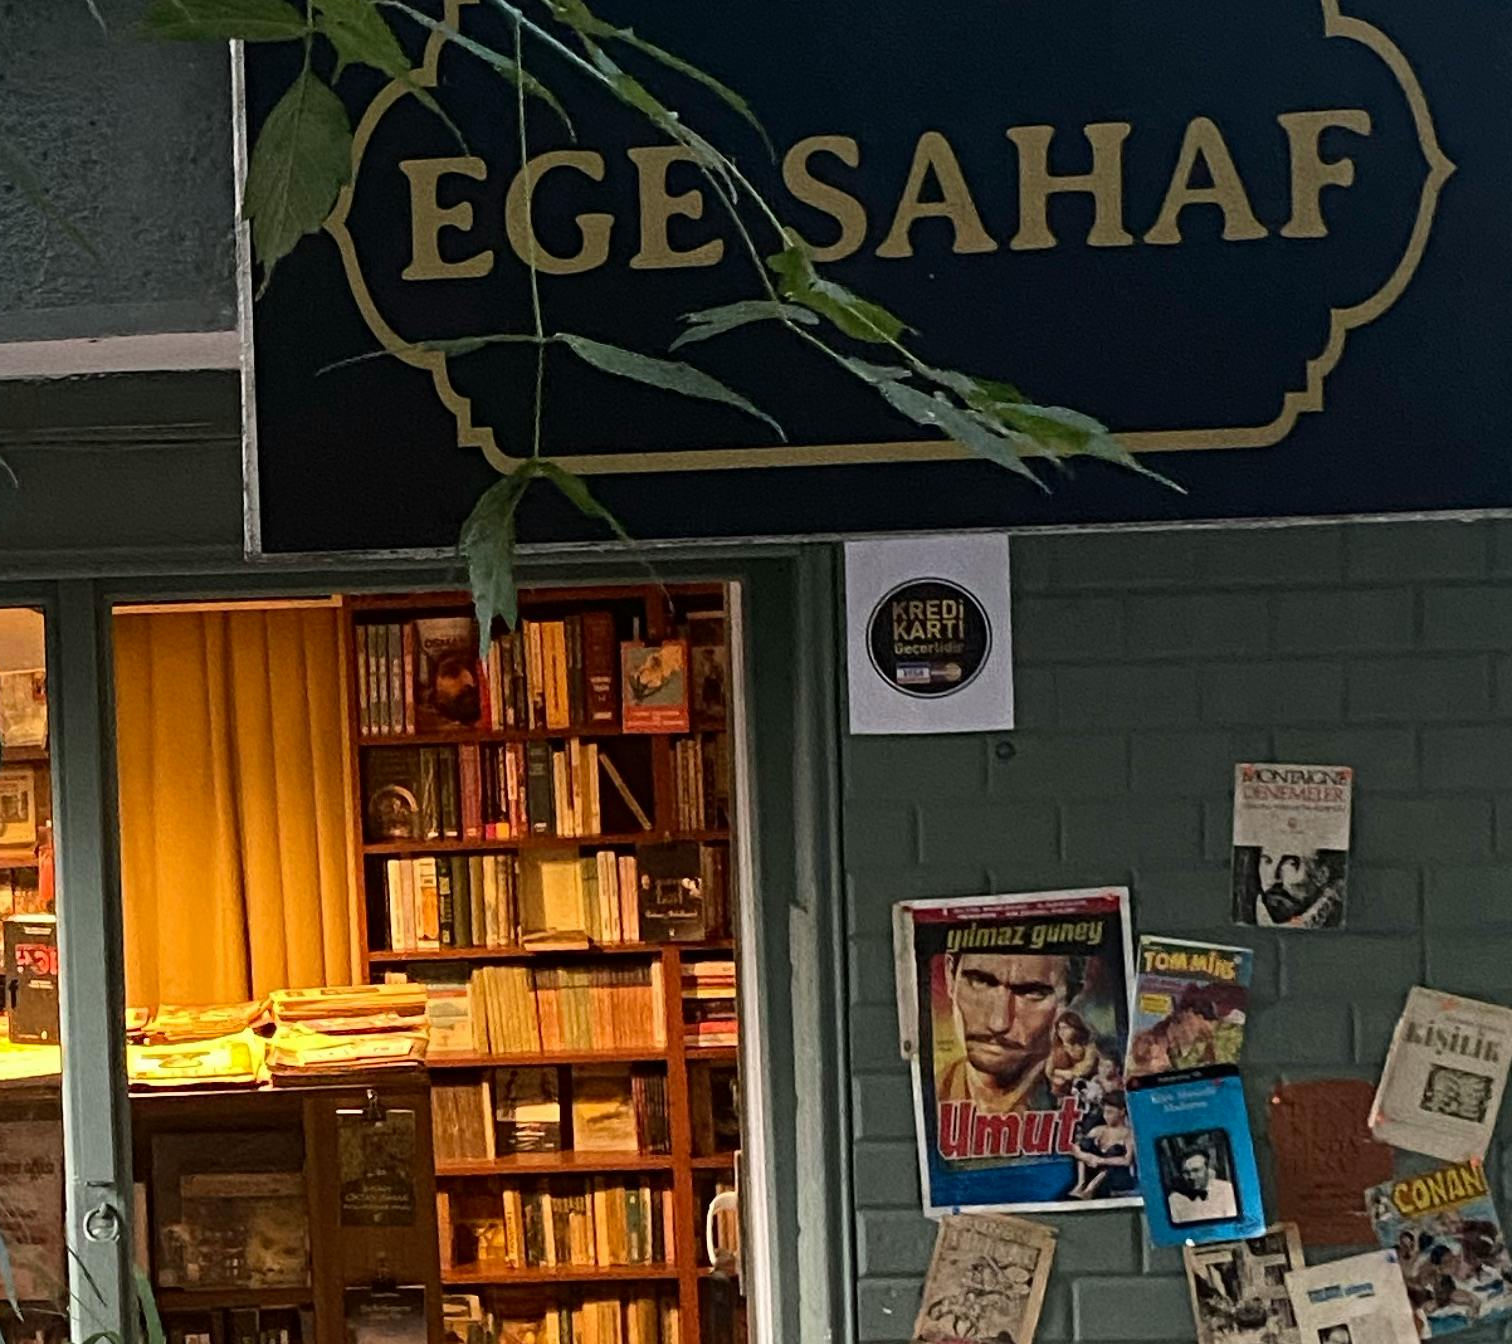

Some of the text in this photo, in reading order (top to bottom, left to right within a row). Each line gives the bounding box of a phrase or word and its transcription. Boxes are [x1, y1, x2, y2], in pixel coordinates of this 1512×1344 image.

[398, 109, 1372, 280] EGE SAHAF
[938, 1095, 1084, 1159] Umut
[1393, 1165, 1486, 1213] CONAN
